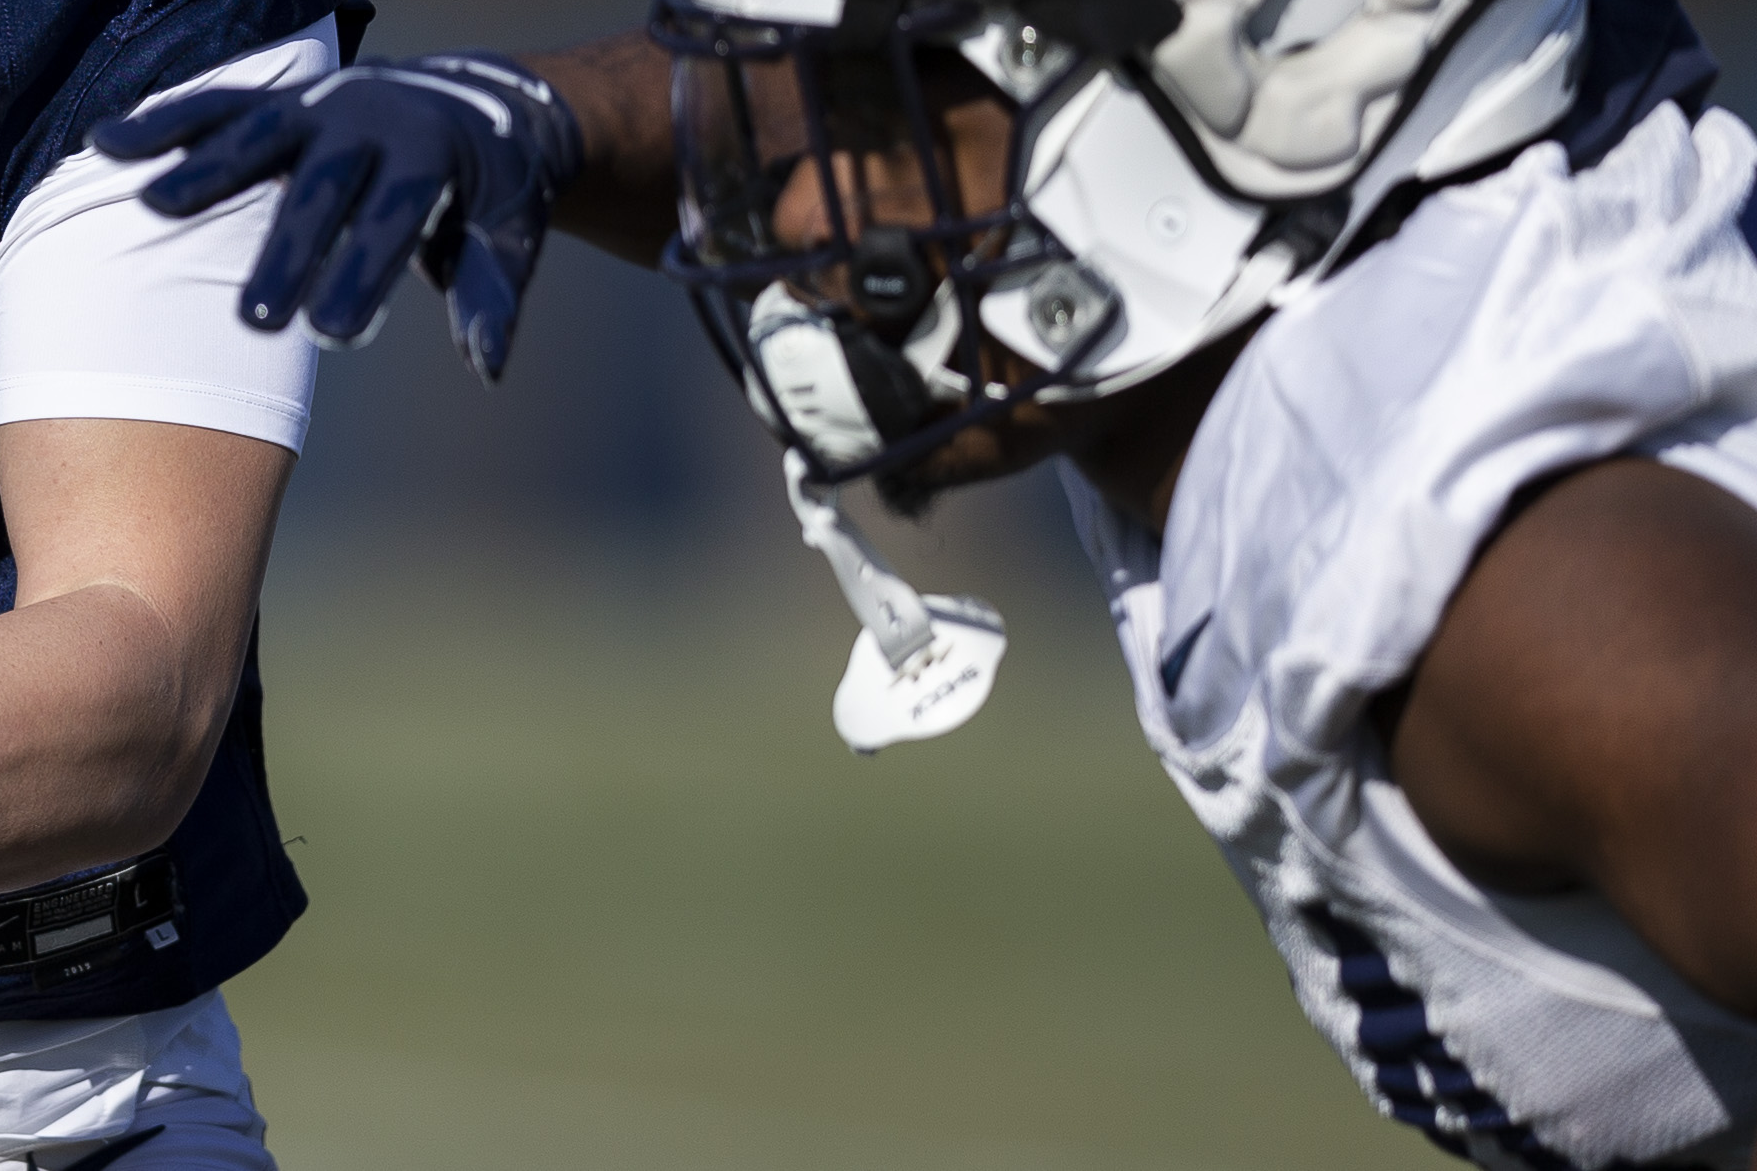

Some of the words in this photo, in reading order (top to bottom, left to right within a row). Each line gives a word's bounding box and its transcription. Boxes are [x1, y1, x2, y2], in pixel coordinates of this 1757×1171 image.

[33, 882, 114, 914] ENGINEERED
[134, 882, 149, 909] L
[155, 929, 170, 943] L
